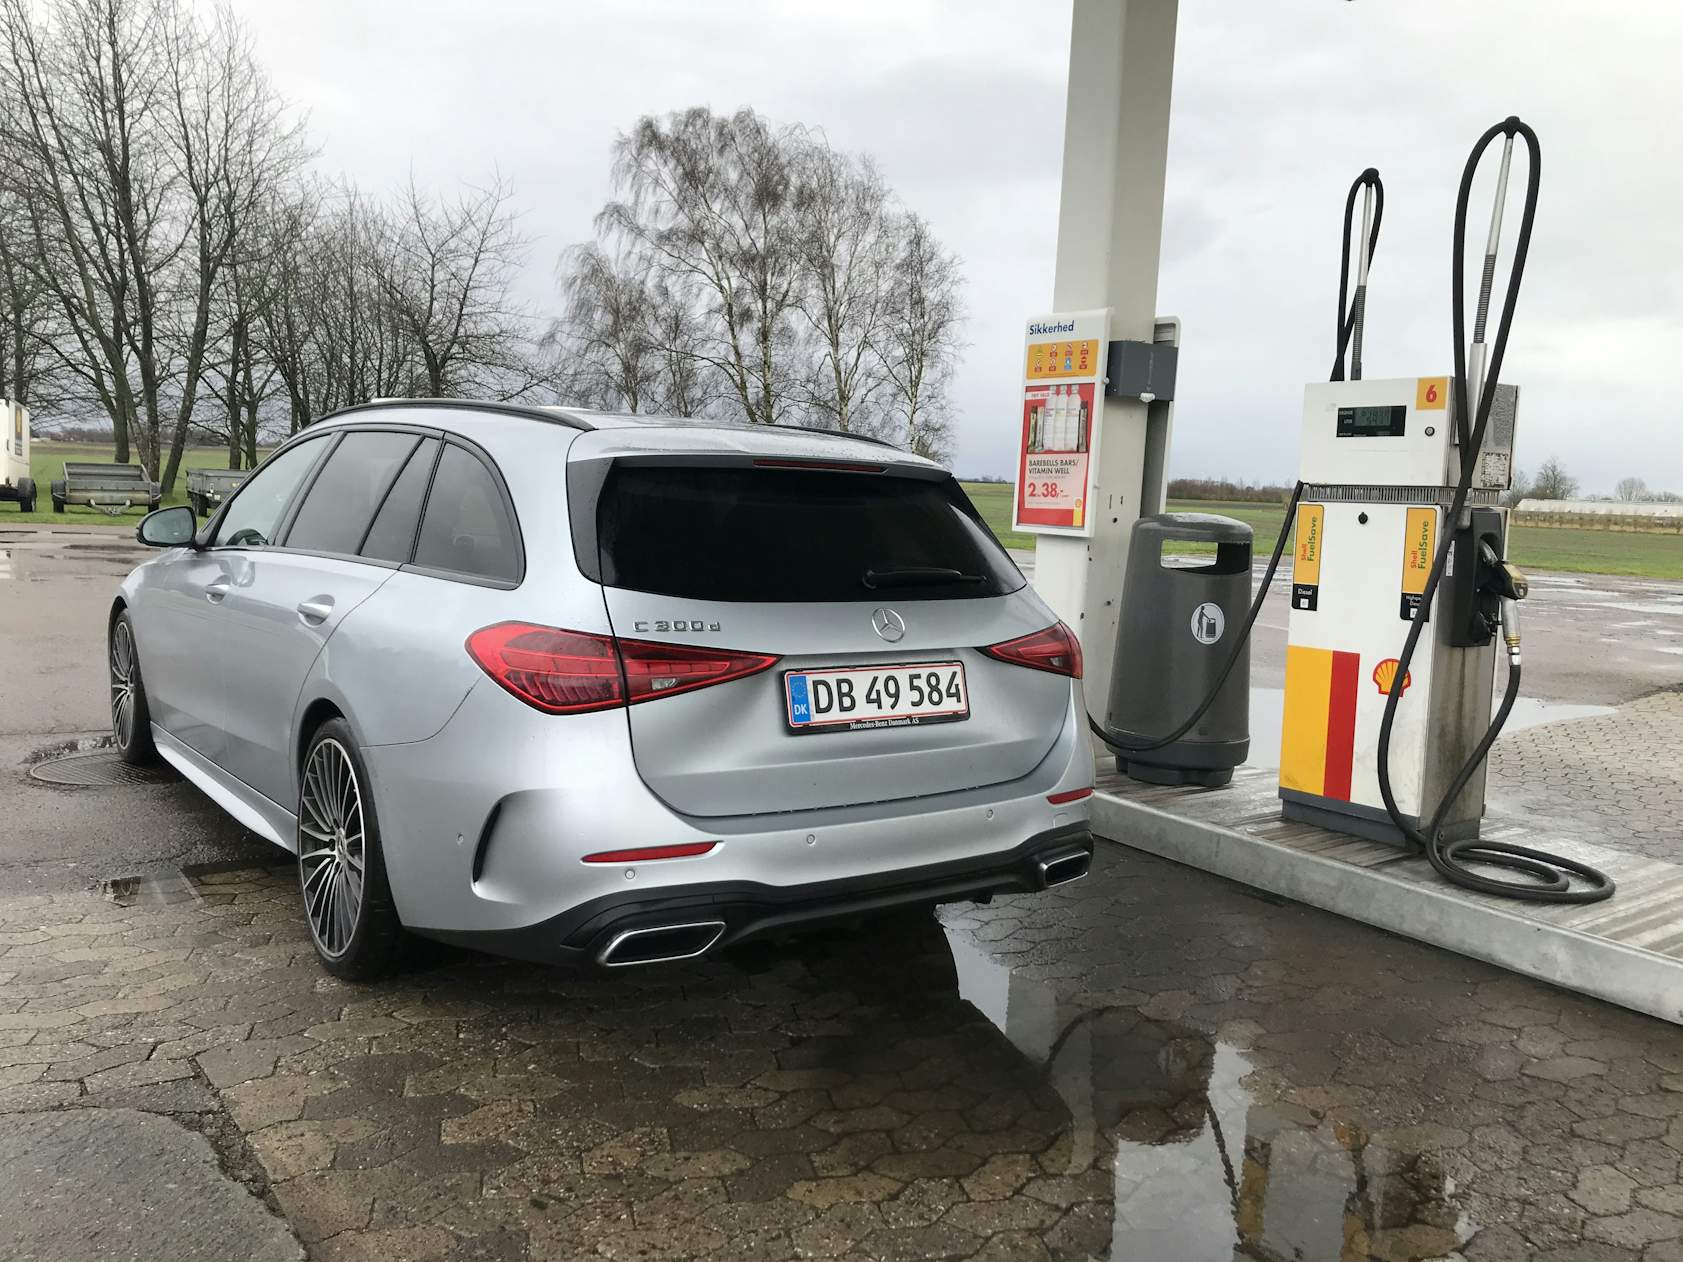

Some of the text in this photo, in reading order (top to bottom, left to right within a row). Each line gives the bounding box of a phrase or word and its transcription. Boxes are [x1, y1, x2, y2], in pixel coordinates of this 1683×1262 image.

[1029, 319, 1075, 336] Sikkerhed
[1425, 384, 1438, 403] 6
[1028, 459, 1059, 467] BAREBELLS
[1028, 467, 1070, 475] VITAMIN WELL
[1307, 516, 1318, 562] FuelSave
[1418, 520, 1429, 568] FuelSave
[1297, 588, 1313, 596] Diesel
[632, 620, 649, 633] C
[812, 671, 962, 714] DB 49 584
[794, 703, 808, 715] DK
[850, 719, 888, 730] Mercedes-Benz
